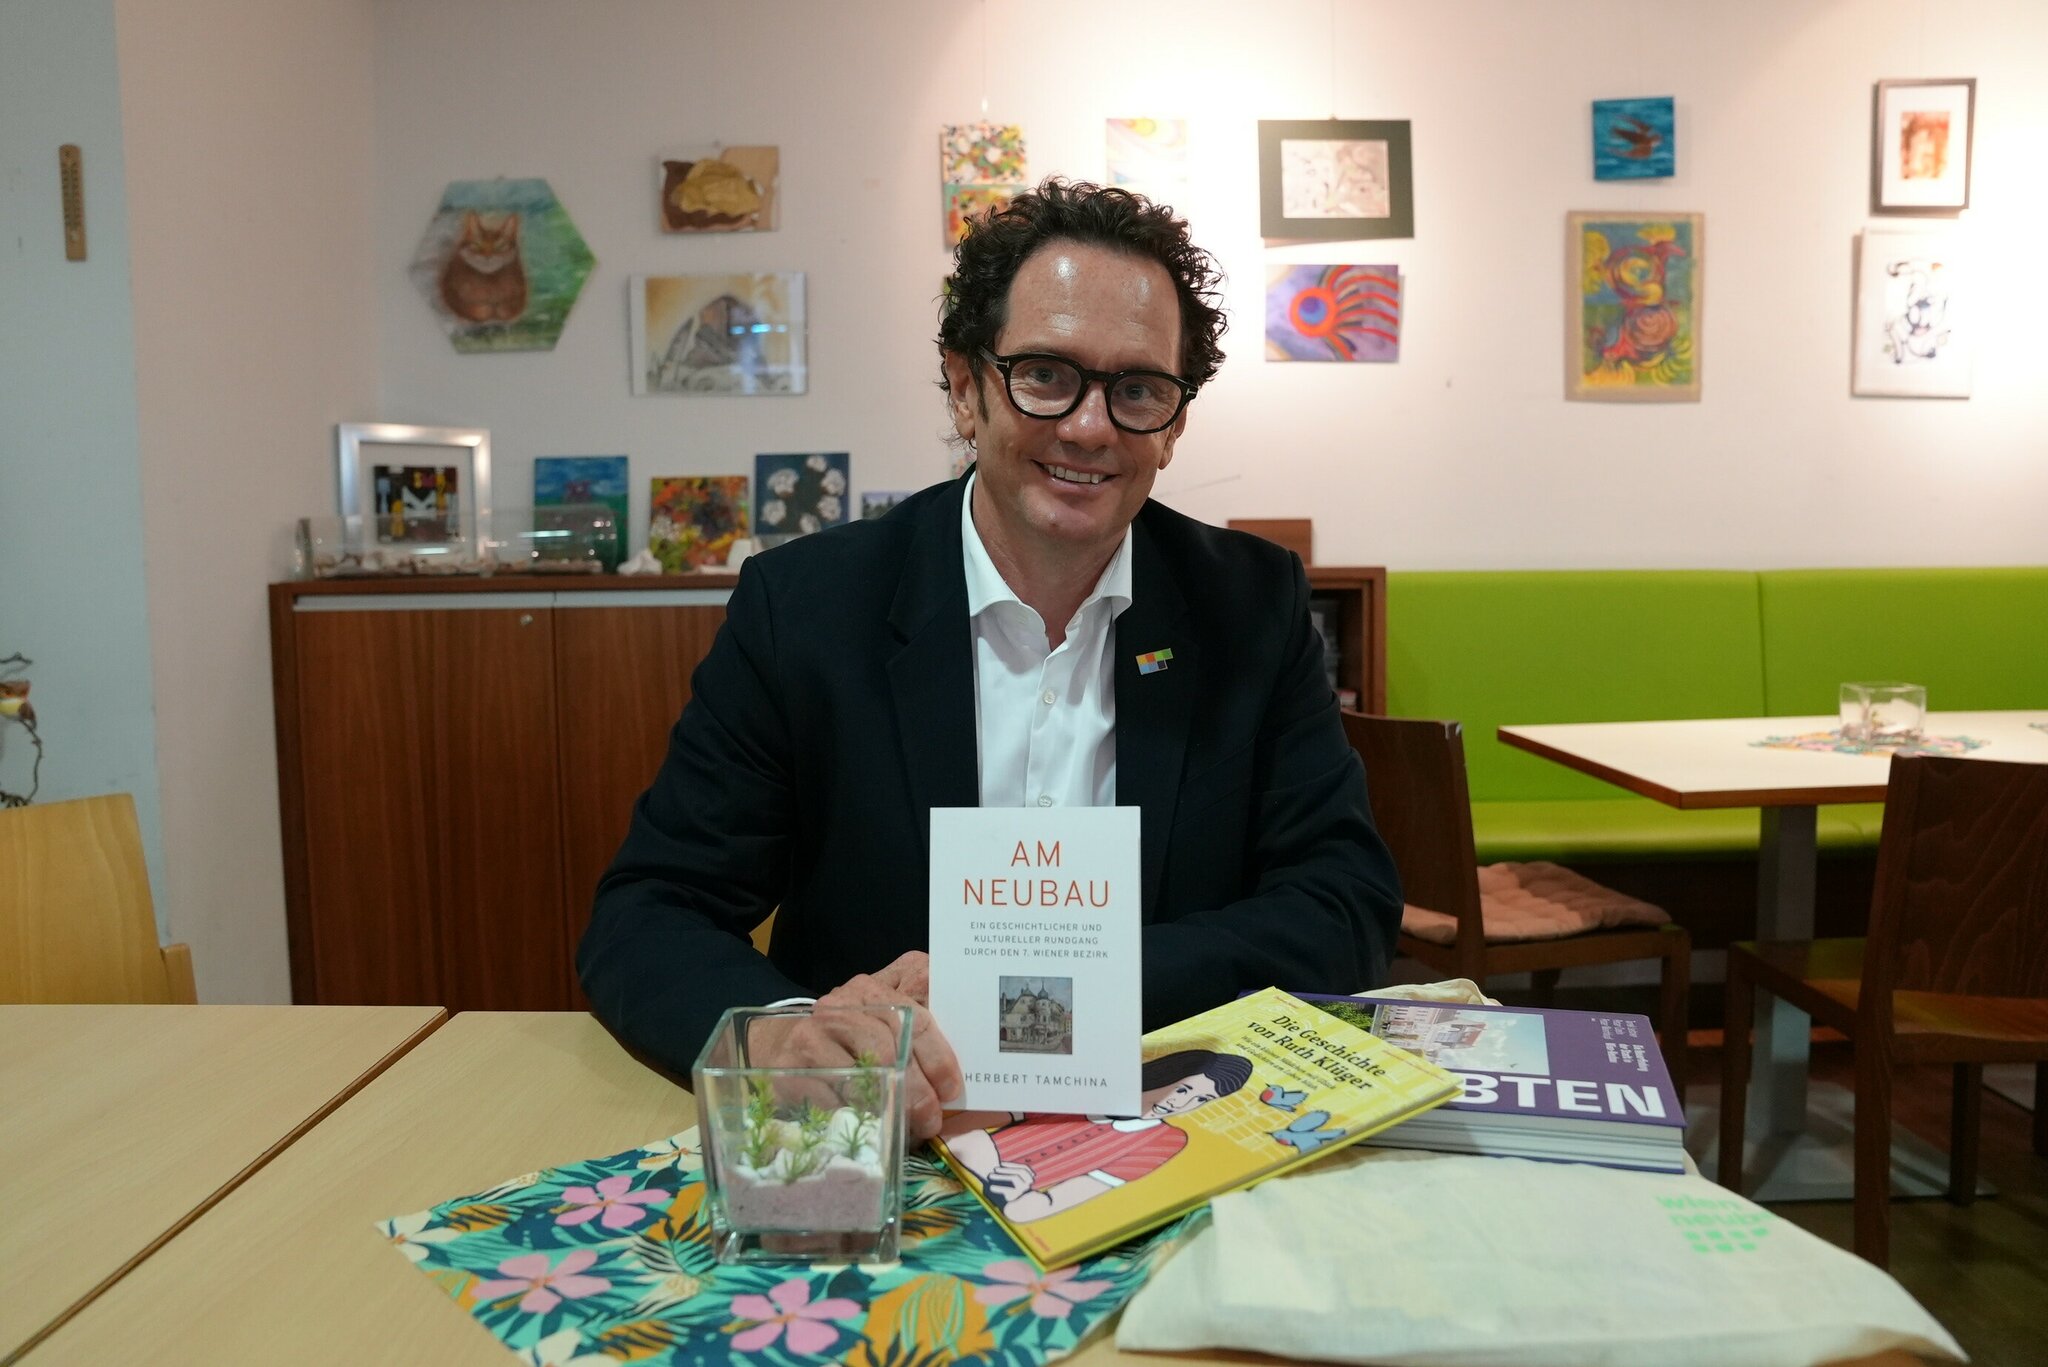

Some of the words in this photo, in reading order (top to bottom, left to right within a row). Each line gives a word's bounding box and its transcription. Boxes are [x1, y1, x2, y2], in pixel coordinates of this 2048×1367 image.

[1011, 840, 1060, 867] AM
[964, 879, 1109, 907] NEUBAU
[970, 921, 986, 930] EIN
[989, 922, 1078, 932] GESCHICHTLICHER
[1081, 923, 1102, 932] UND
[974, 935, 1041, 944] KULTURELLER
[1044, 936, 1099, 945] RUNDGANG
[964, 948, 997, 956] DURCH
[1000, 948, 1020, 957] DEN
[1023, 949, 1030, 957] 7.
[1033, 949, 1069, 958] WIENER
[1073, 950, 1109, 959] BEZIRK
[1247, 1020, 1275, 1039] von
[1275, 1034, 1314, 1065] Ruth
[1311, 1055, 1374, 1091] Klüger
[1272, 1015, 1300, 1033] Die
[1299, 1027, 1386, 1077] Geschichte
[965, 1072, 1028, 1084] HERBERT
[1036, 1075, 1108, 1087] TAMCHINA
